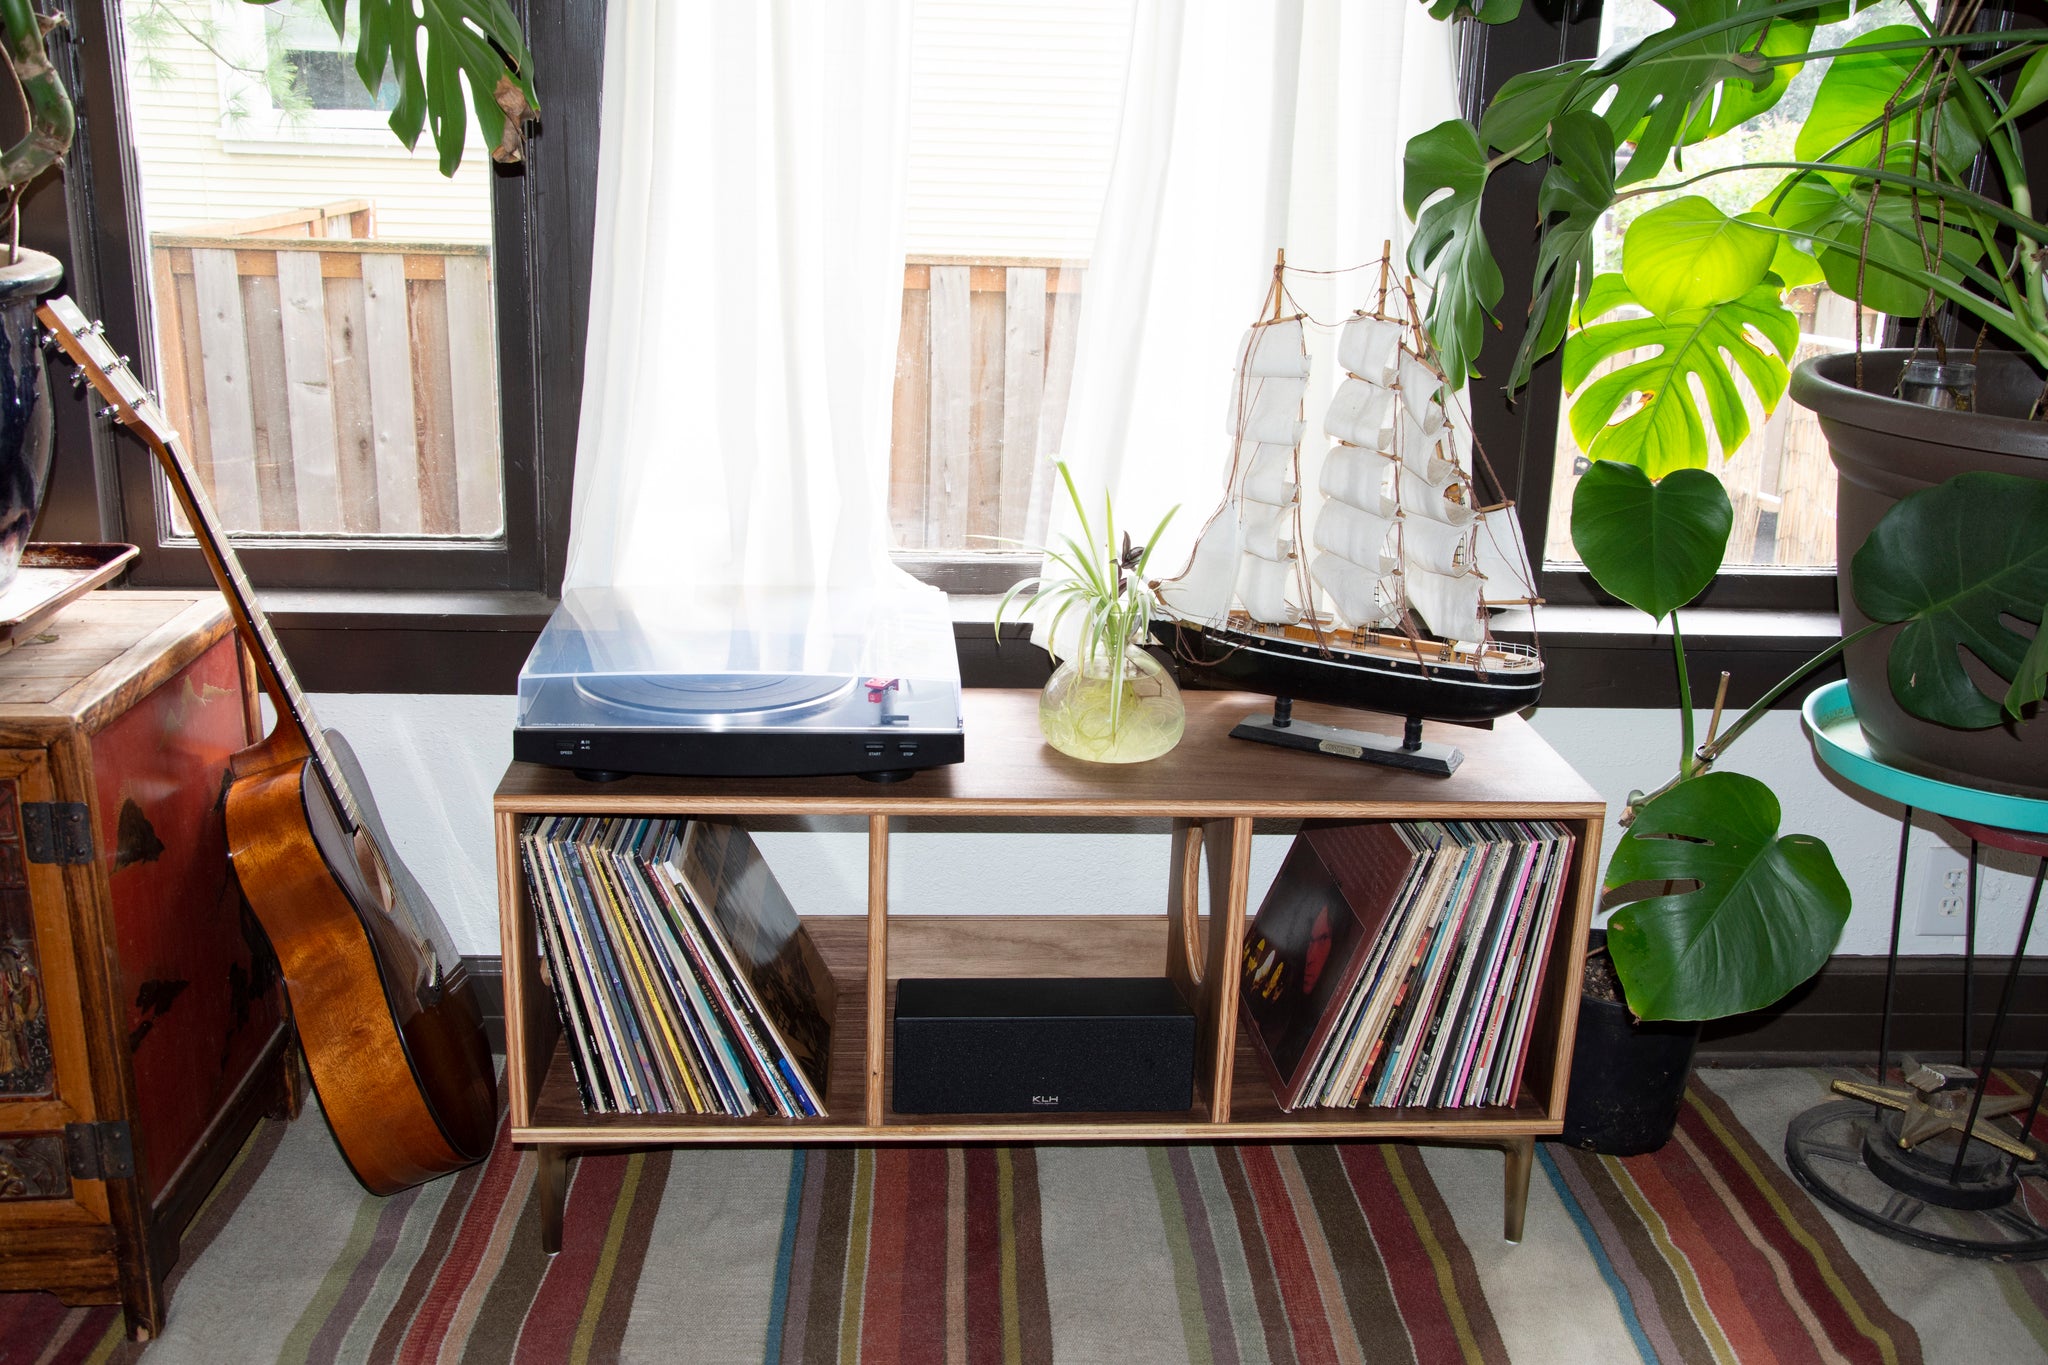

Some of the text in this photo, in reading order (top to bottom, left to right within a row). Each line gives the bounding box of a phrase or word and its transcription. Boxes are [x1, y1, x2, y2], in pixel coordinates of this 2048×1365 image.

[693, 969, 702, 982] ALL
[702, 983, 719, 1013] MIRRORS
[1032, 1095, 1059, 1103] KLH
